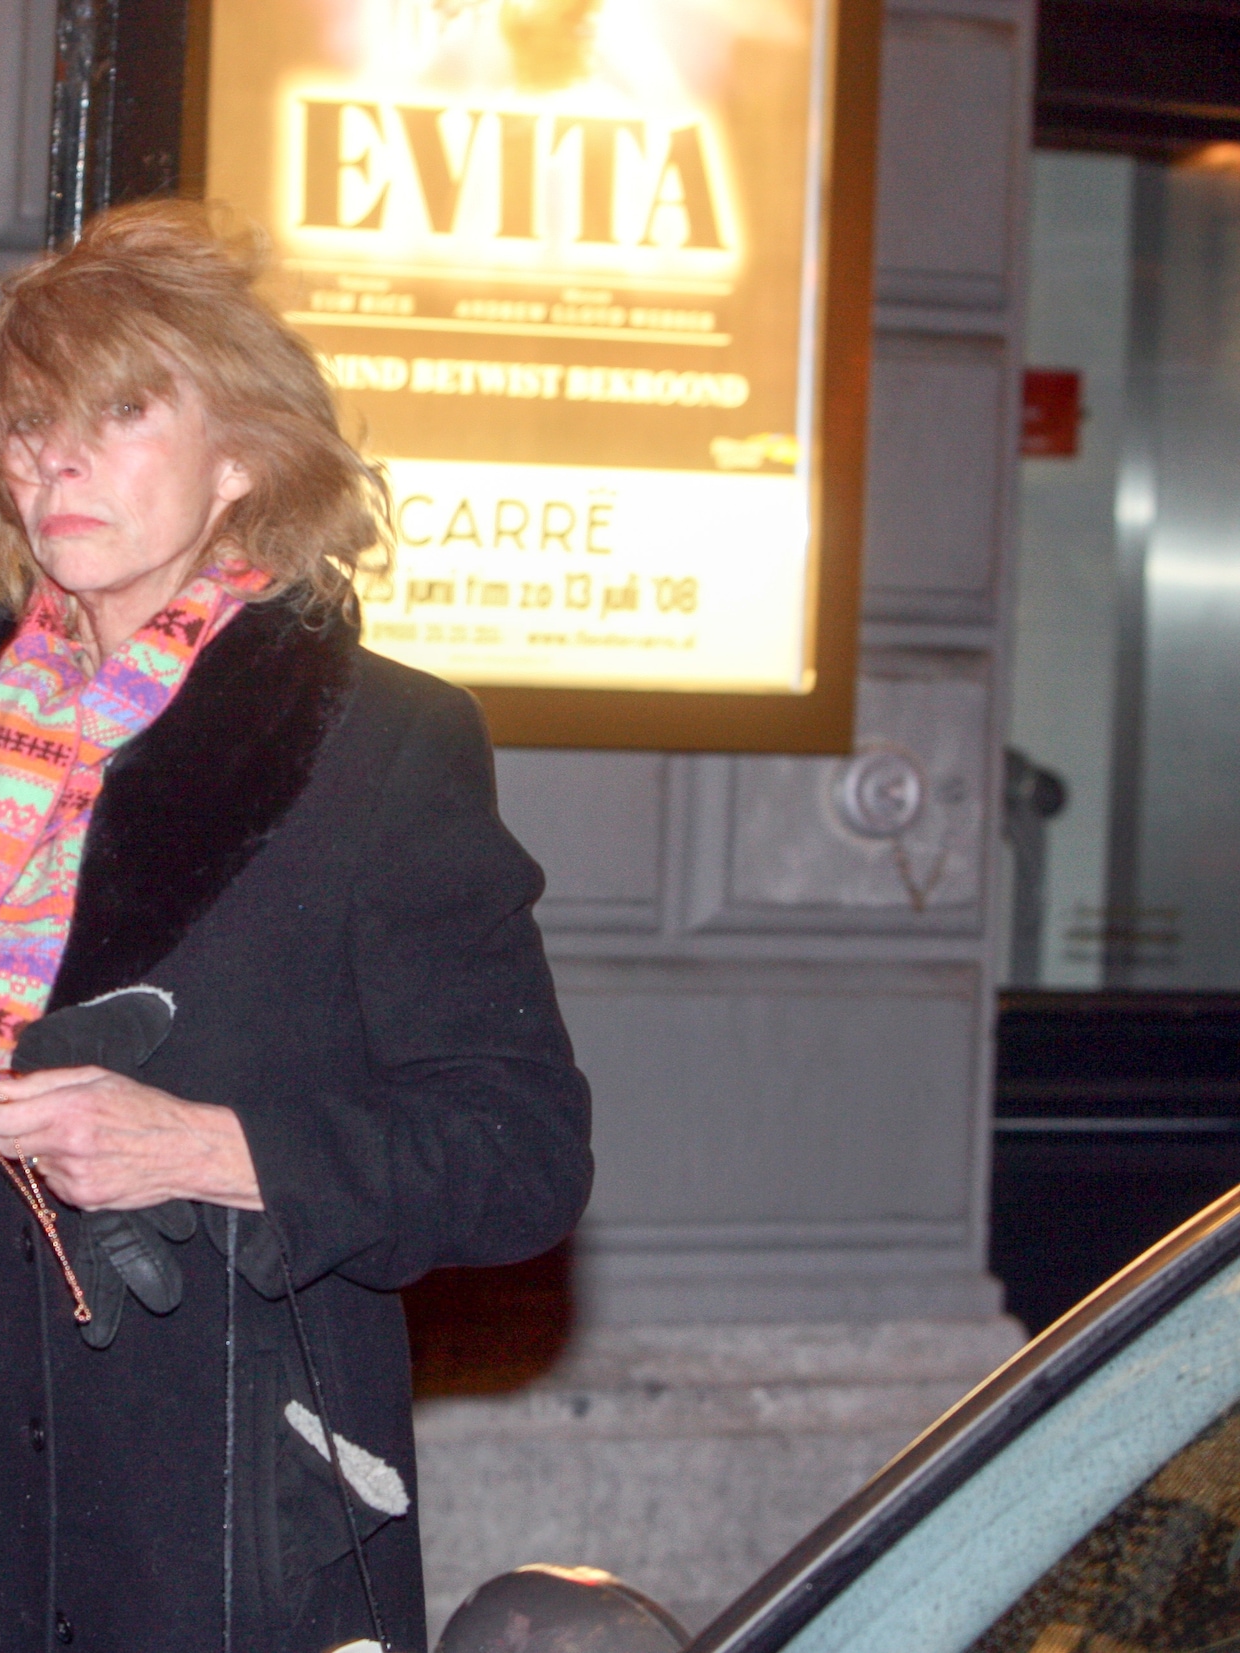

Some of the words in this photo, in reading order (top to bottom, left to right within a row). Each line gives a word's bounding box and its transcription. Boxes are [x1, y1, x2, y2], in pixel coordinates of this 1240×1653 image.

[297, 100, 731, 251] EVITA
[410, 357, 564, 400] BETWIST
[565, 364, 750, 409] BEKROOND
[564, 572, 592, 611] 13
